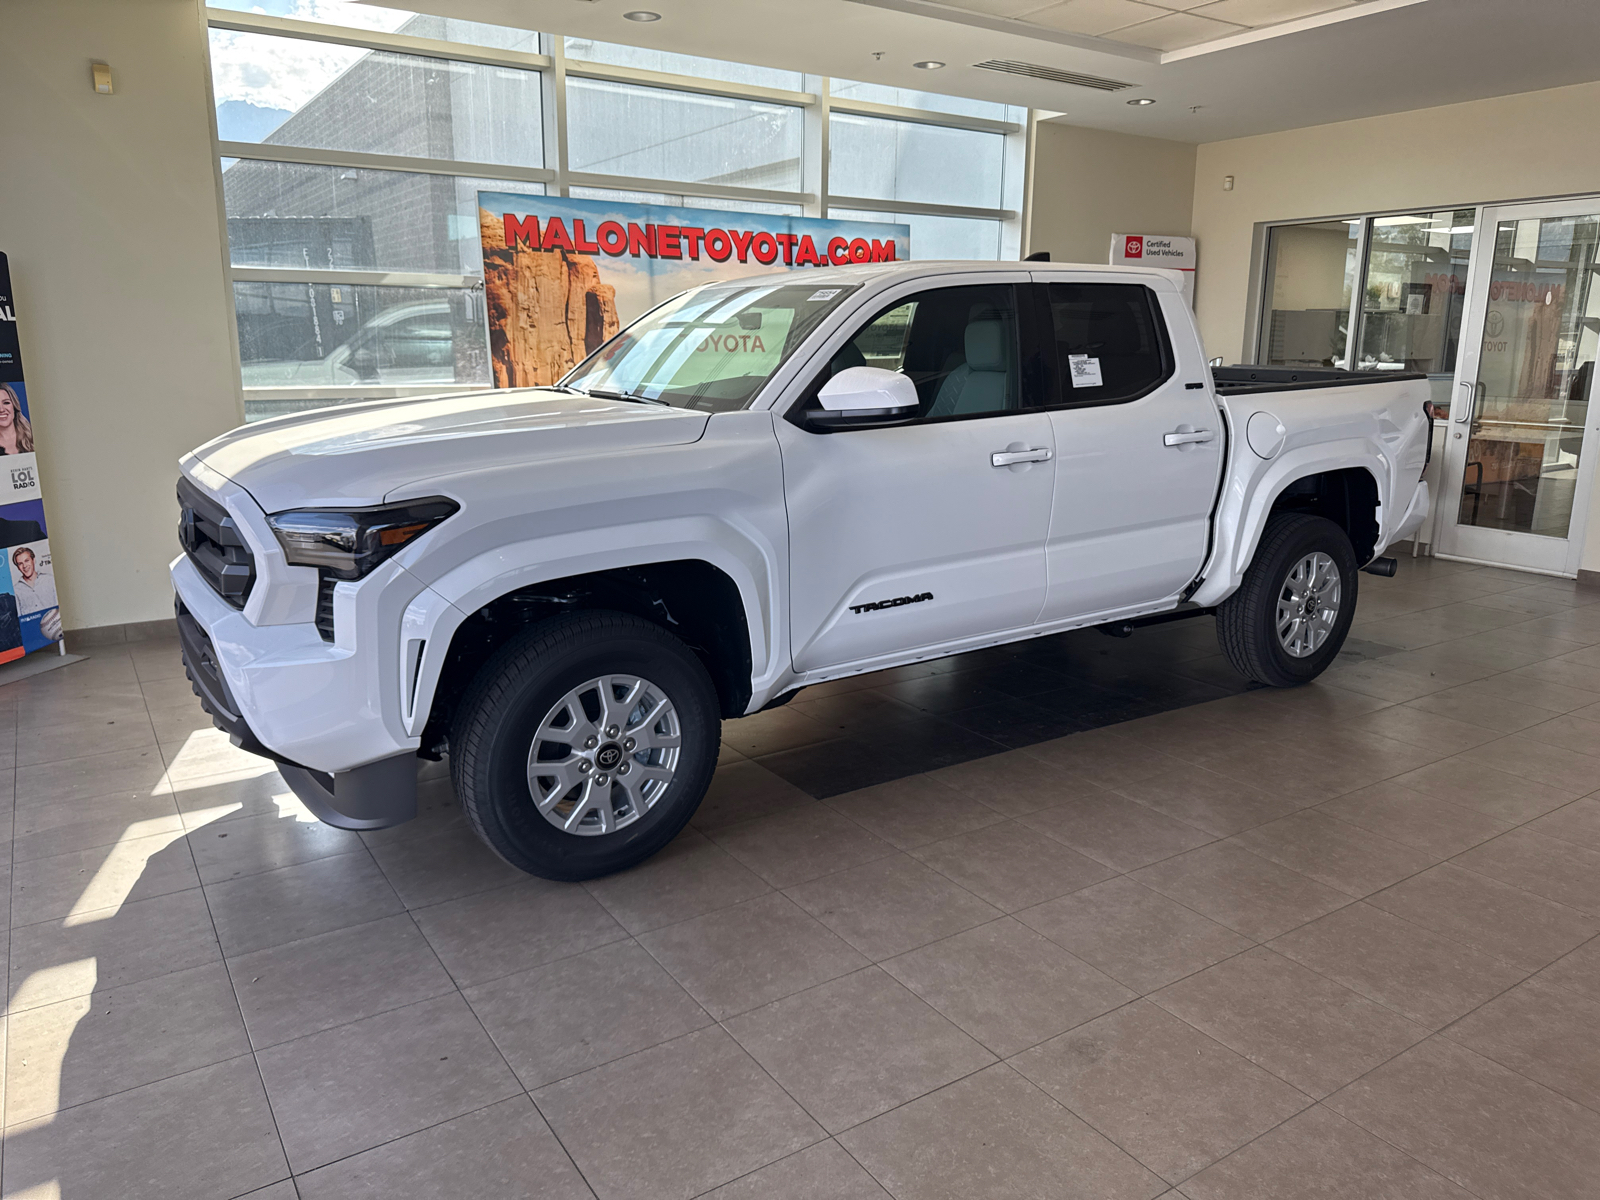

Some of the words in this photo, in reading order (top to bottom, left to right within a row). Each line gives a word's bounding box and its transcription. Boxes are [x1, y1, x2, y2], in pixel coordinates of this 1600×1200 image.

[503, 213, 895, 265] MALONETOYOTA.COM
[12, 471, 34, 483] LOL
[848, 592, 934, 614] TACOMA
